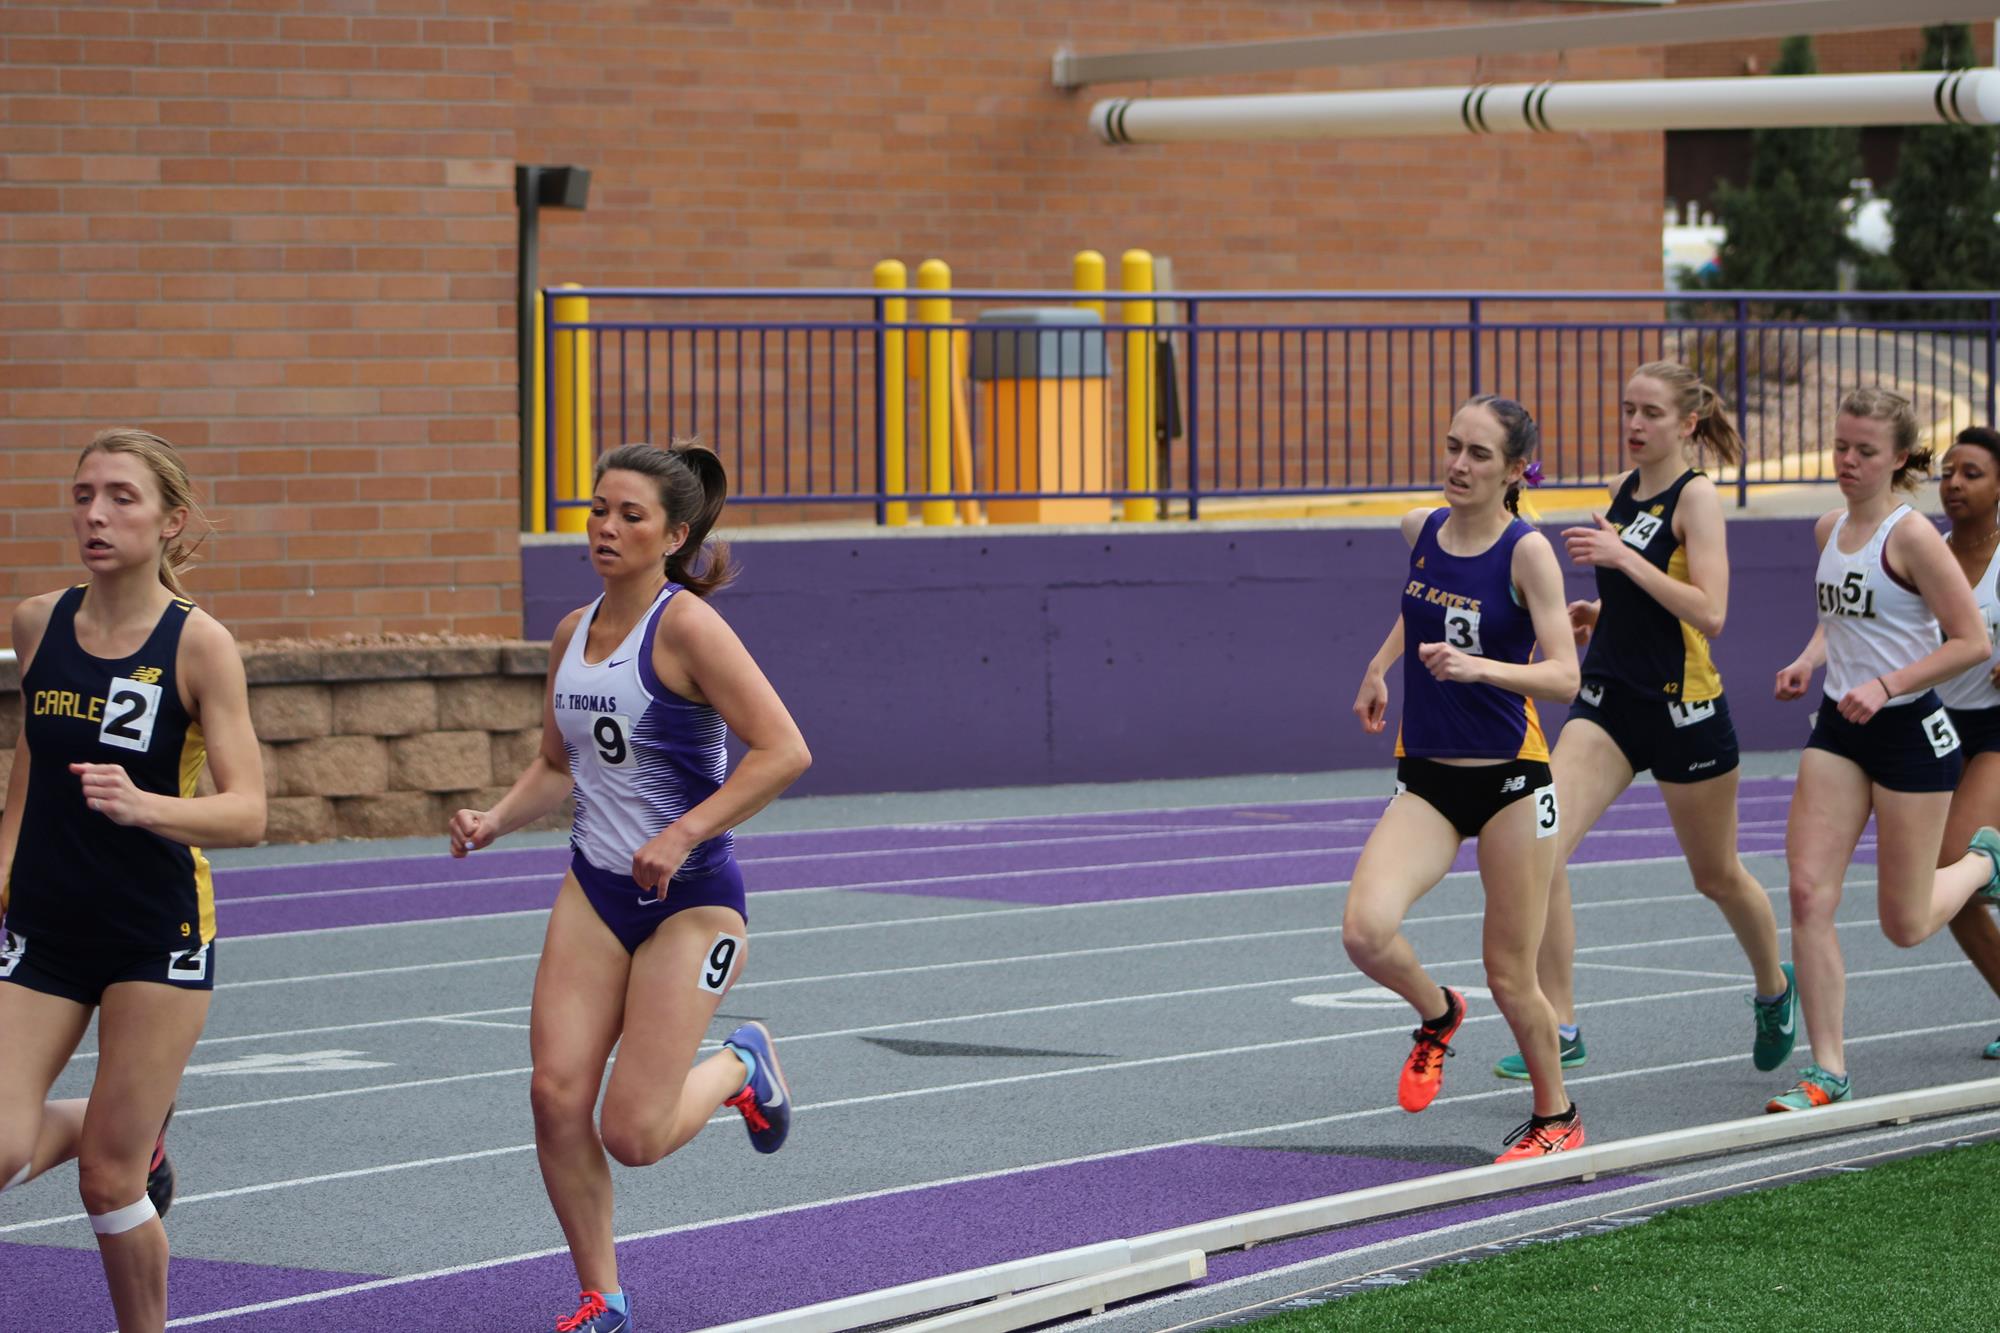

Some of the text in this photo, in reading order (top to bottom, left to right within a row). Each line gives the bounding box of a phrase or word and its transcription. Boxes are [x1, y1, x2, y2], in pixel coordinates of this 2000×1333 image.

[1629, 516, 1657, 541] 14
[1405, 580, 1483, 613] ST. KATE'S
[1842, 571, 1864, 604] 5
[1448, 616, 1474, 649] 3
[568, 694, 617, 713] THOMAS
[1663, 681, 1679, 694] 42
[103, 690, 148, 741] 2
[594, 716, 627, 765] 9
[1931, 718, 1954, 749] 5
[1540, 793, 1556, 829] 3
[180, 922, 191, 937] 9
[706, 938, 736, 989] 9
